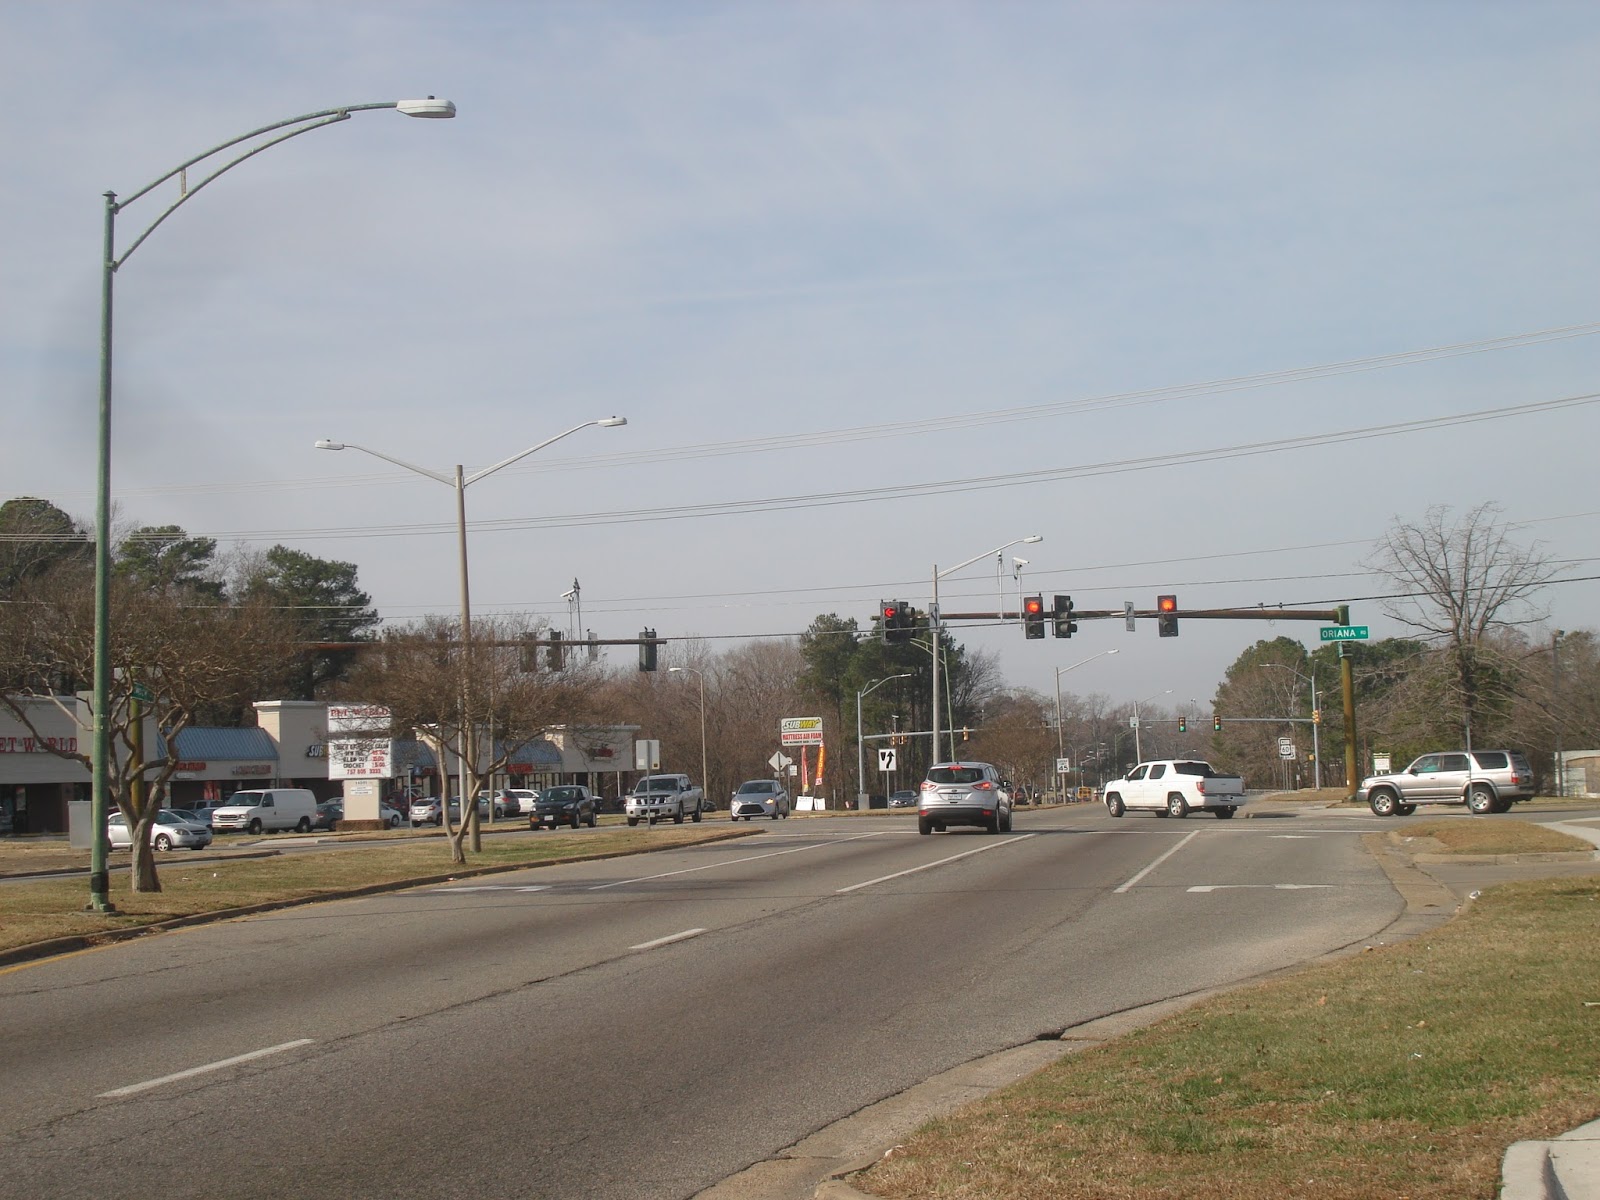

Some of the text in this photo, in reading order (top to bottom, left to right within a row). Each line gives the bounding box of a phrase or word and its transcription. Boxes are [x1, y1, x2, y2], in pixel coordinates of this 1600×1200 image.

[1322, 629, 1356, 638] ORIANA
[783, 719, 821, 730] SUBWAY
[22, 737, 78, 752] WRLD
